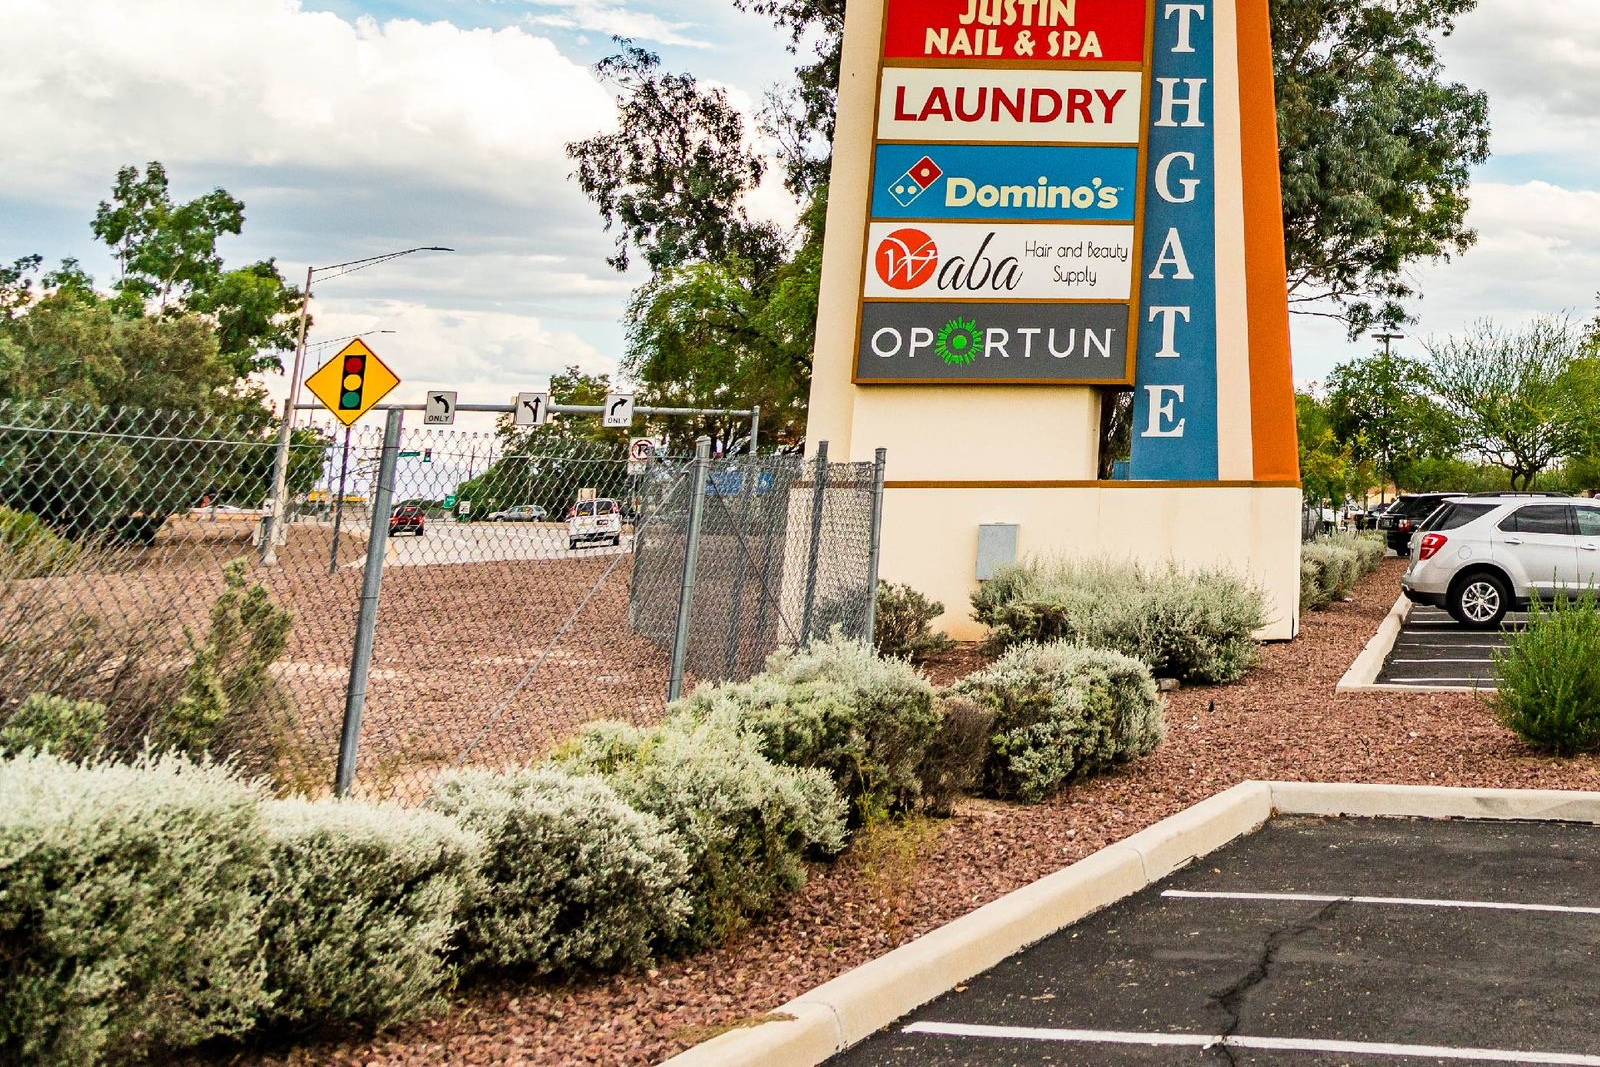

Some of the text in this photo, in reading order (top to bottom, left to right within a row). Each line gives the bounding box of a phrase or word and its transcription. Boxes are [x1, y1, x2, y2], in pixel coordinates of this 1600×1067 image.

[924, 27, 1103, 59] NAIL & SPA
[893, 85, 1127, 124] LAUNDRY
[945, 176, 1119, 210] Domino's
[1025, 240, 1128, 262] Hair and Beauty
[1053, 265, 1097, 286] Supply
